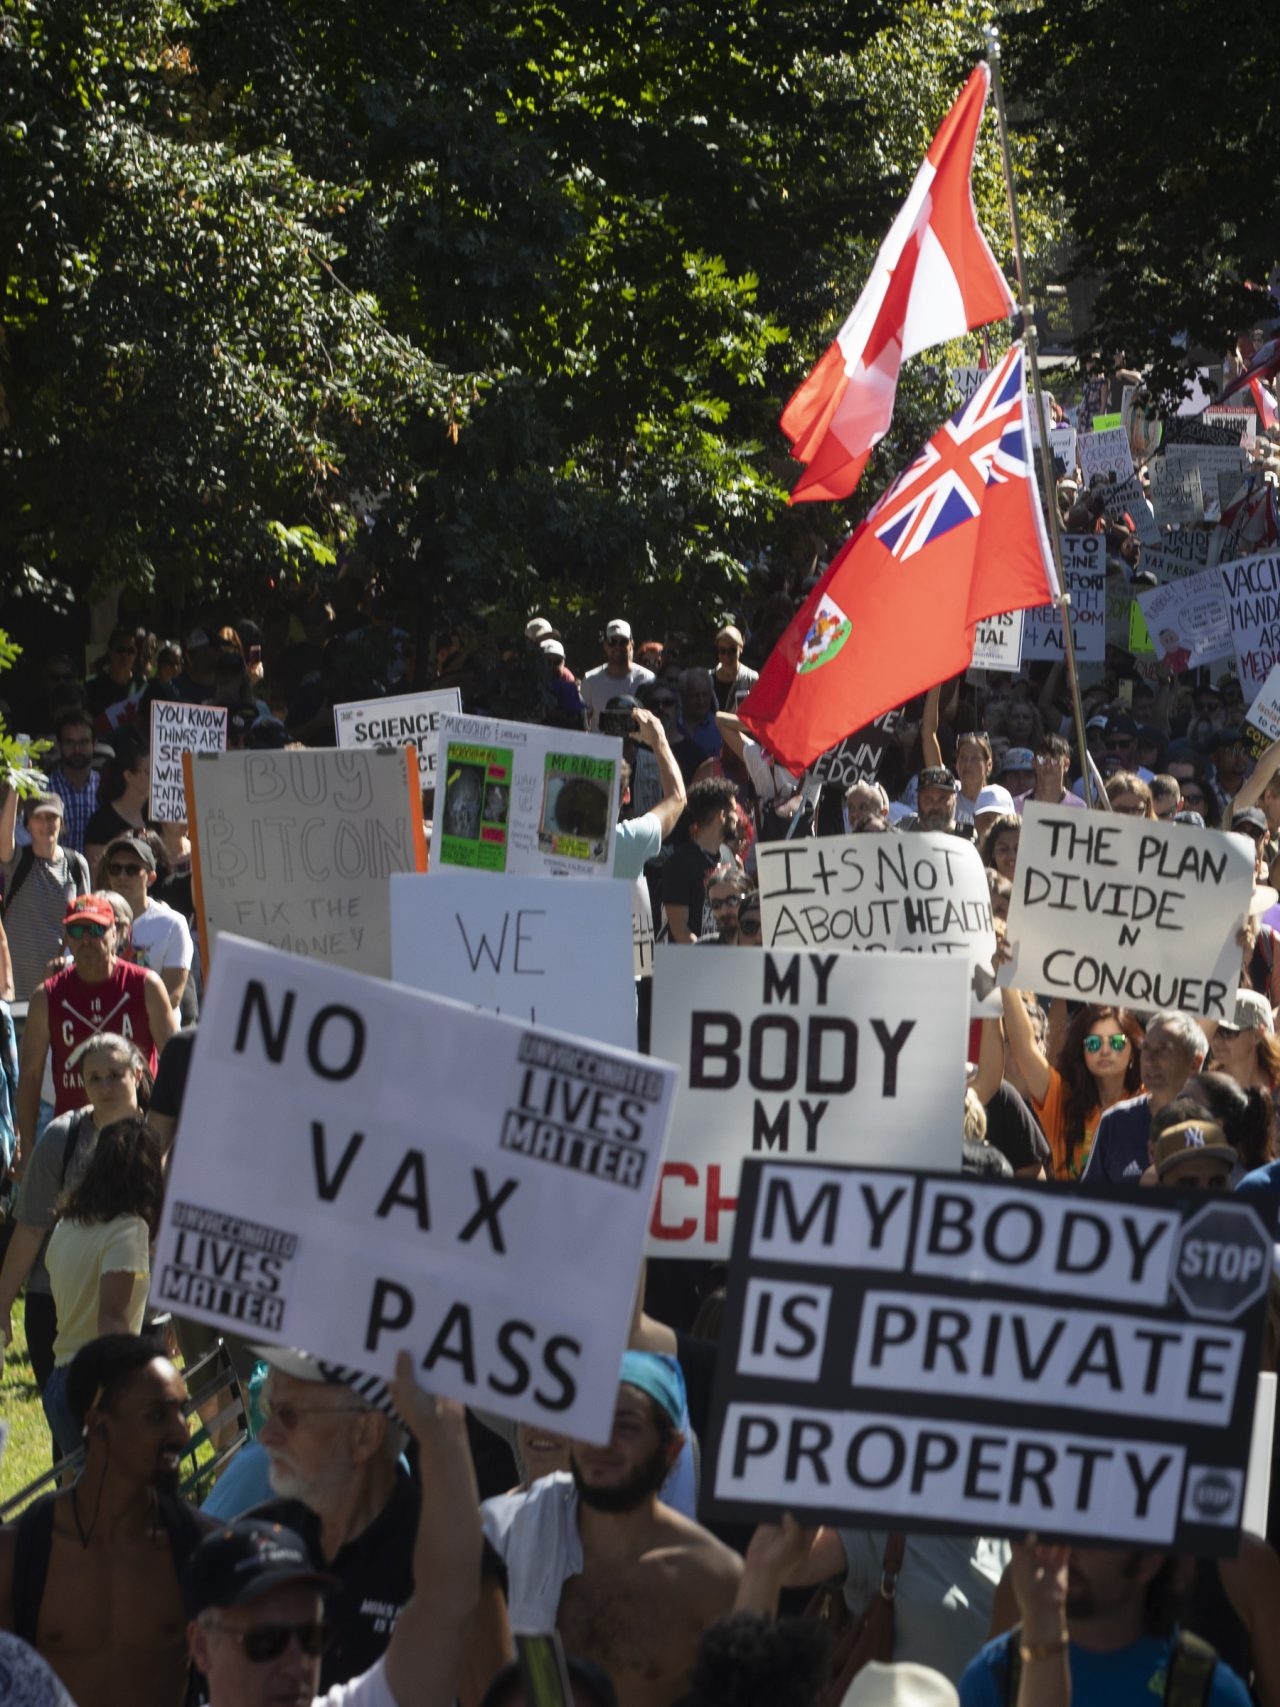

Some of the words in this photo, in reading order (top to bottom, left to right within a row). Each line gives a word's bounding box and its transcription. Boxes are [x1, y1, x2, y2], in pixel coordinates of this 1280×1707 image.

[1065, 538, 1099, 553] TO
[1044, 629, 1087, 651] ALL
[155, 724, 198, 745] THINGS
[200, 730, 225, 750] ARE
[156, 703, 184, 724] YOU
[188, 707, 226, 728] KNOW
[355, 711, 440, 742] SCIENCE
[1258, 715, 1269, 728] to
[156, 765, 183, 783] WHE
[244, 752, 374, 813] BUY
[552, 756, 569, 770] MY
[204, 808, 412, 888] BITCOIN
[1038, 819, 1123, 866] THE
[1138, 835, 1228, 886] PLAN
[233, 901, 290, 926] FIX
[304, 897, 361, 921] THE
[770, 899, 900, 948] ABOUT
[904, 896, 995, 937] HEALTH
[1024, 867, 1187, 931] DIVIDE
[456, 910, 546, 974] WE
[1118, 923, 1141, 947] N
[763, 953, 839, 1006] MY
[1043, 949, 1228, 1017] CONQUER
[234, 979, 367, 1083] NO
[688, 1011, 917, 1098] BODY
[519, 1033, 664, 1101] UNVACCINATED
[517, 1070, 647, 1144] LIVES
[750, 1099, 829, 1153] MY
[503, 1110, 645, 1191] MATTER
[310, 1121, 521, 1257] VAX
[172, 1202, 297, 1260] UNVACCINATED
[758, 1176, 906, 1253] MY
[926, 1190, 1170, 1284] BODY
[1180, 1240, 1263, 1281] STOP
[172, 1233, 283, 1295] LIVES
[161, 1266, 284, 1331] MATTER
[363, 1277, 582, 1414] PASS
[750, 1292, 822, 1361] IS
[869, 1303, 1235, 1404] PRIVATE
[731, 1415, 1175, 1519] PROPERTY
